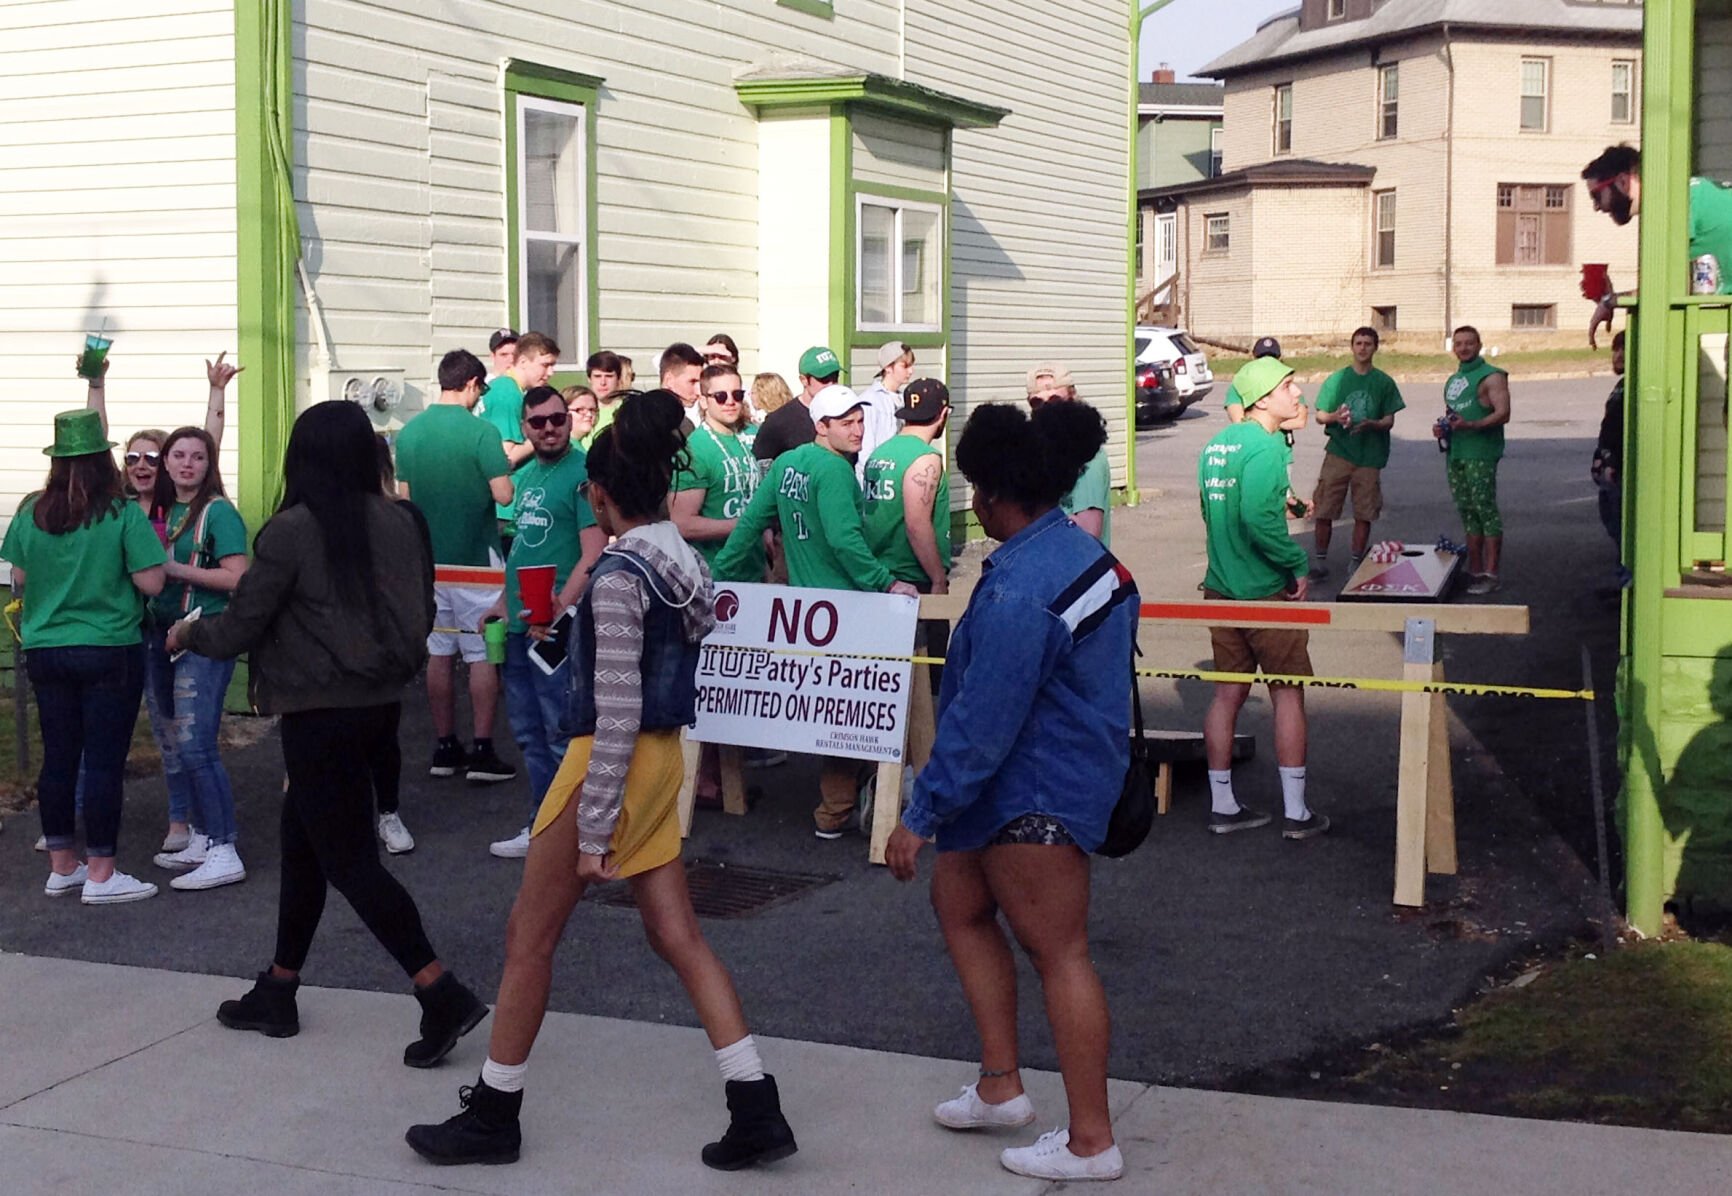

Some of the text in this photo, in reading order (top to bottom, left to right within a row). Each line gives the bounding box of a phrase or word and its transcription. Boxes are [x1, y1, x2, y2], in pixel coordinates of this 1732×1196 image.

[911, 394, 920, 408] P
[767, 598, 839, 647] NO
[828, 659, 901, 694] Parties
[697, 685, 897, 732] PERMITTED ON PREMISES
[815, 739, 893, 755] RENTALS MANAGEMENT
[830, 731, 879, 744] CRIMSON HAWK
